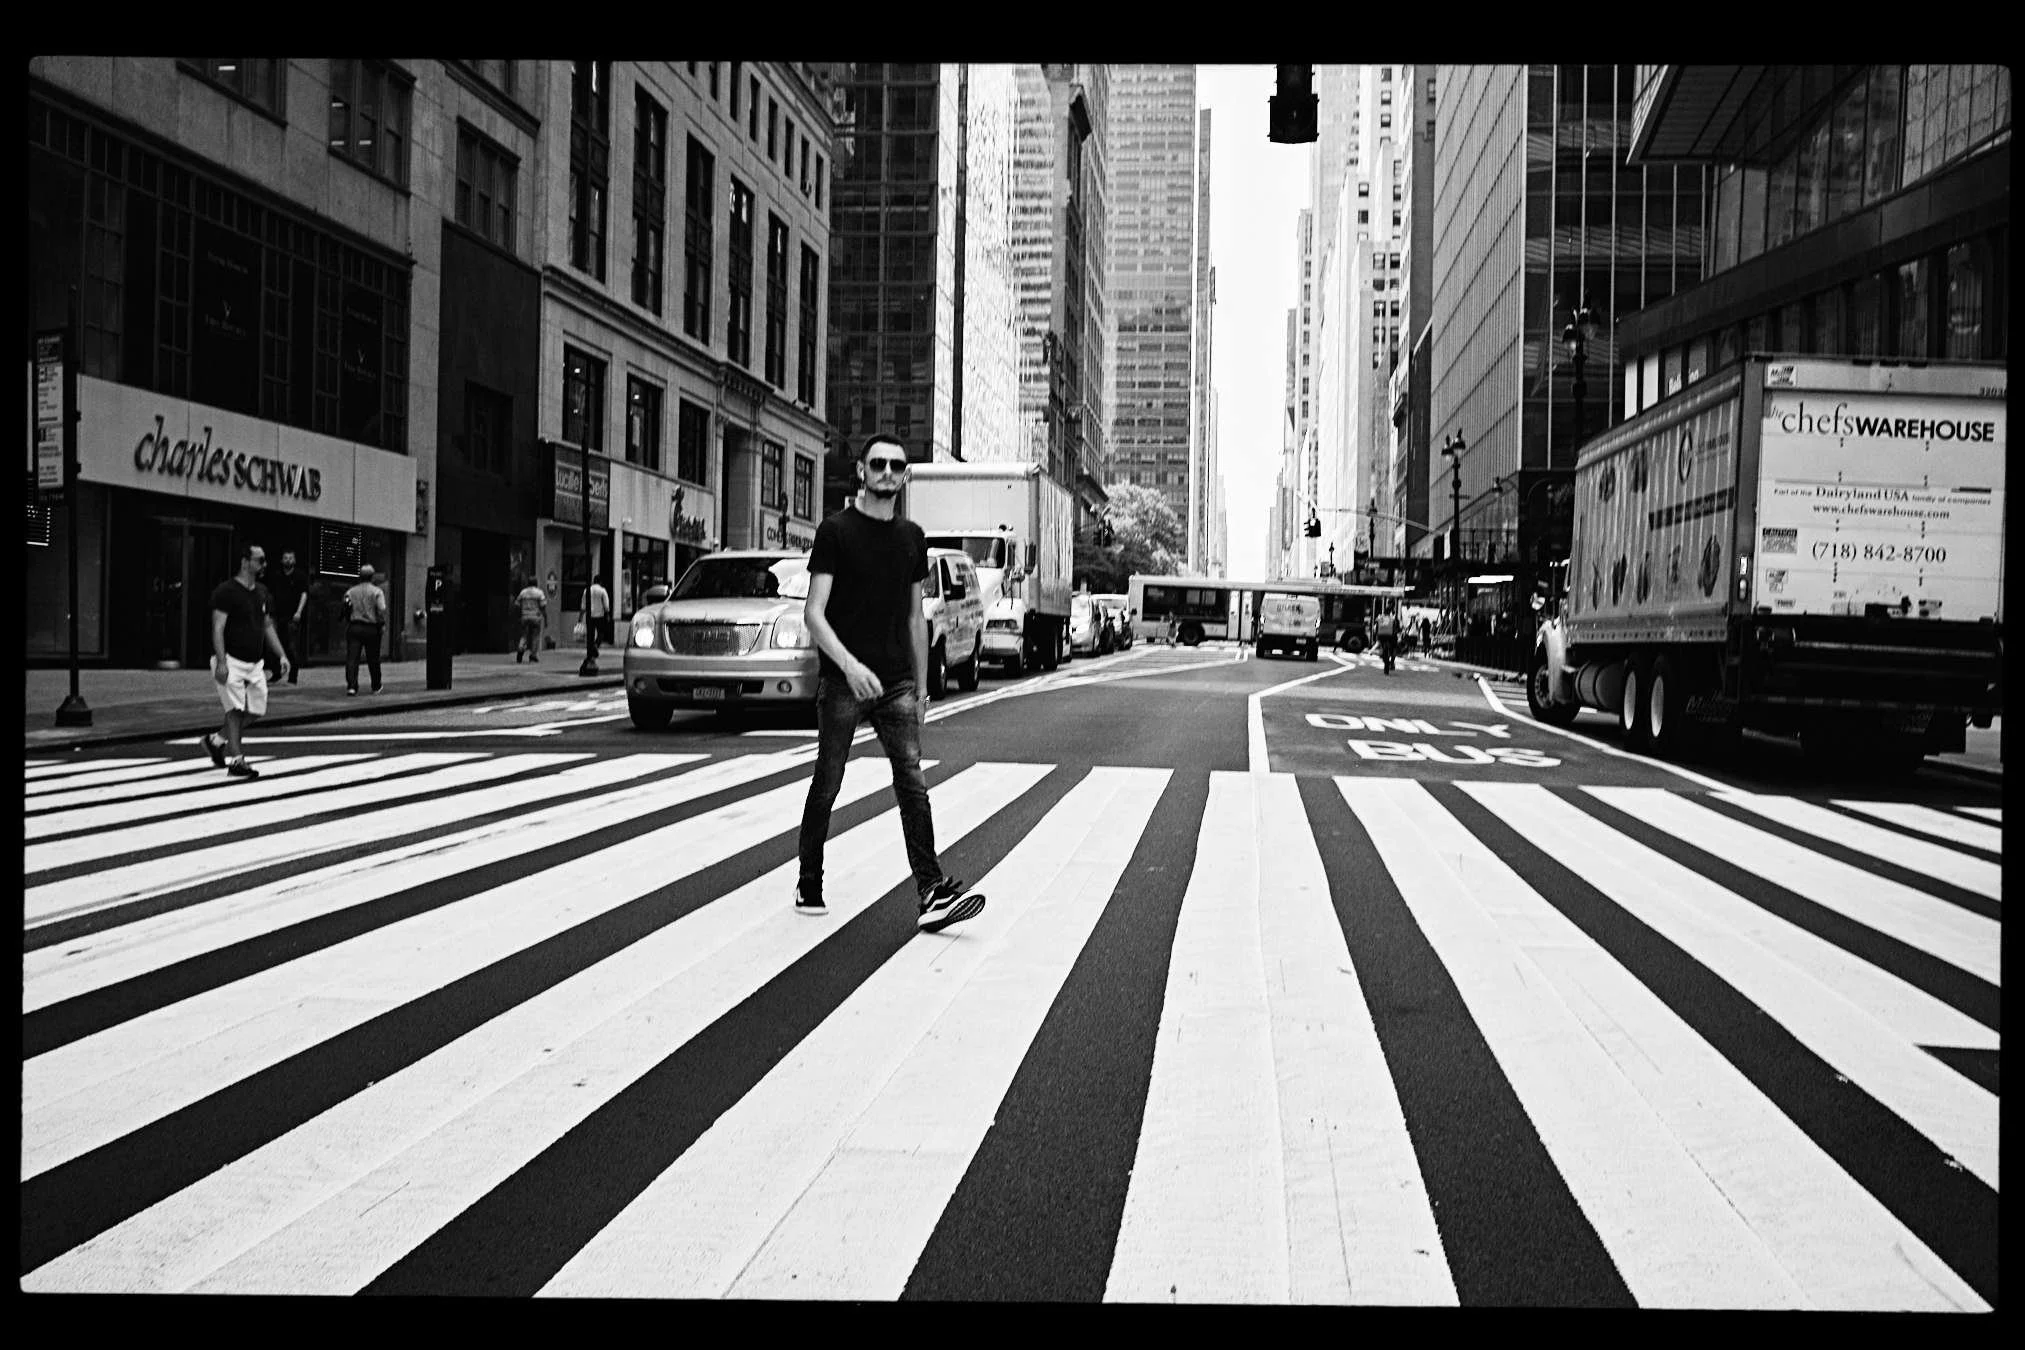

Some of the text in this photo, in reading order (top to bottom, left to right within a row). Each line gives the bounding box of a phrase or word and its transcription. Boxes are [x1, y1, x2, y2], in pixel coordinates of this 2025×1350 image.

[1855, 416, 1995, 443] WAREHOUSE
[134, 414, 233, 486] charles
[233, 452, 322, 502] SCHWAB
[1816, 485, 1881, 502] Dairyland
[1884, 488, 1909, 502] USA
[1813, 502, 1950, 520] www.chefswarehouse.com
[1812, 541, 1857, 562] (718)
[1863, 543, 1947, 564] 842-8700
[1305, 714, 1511, 738] ONLY
[1348, 740, 1562, 767] BUS
